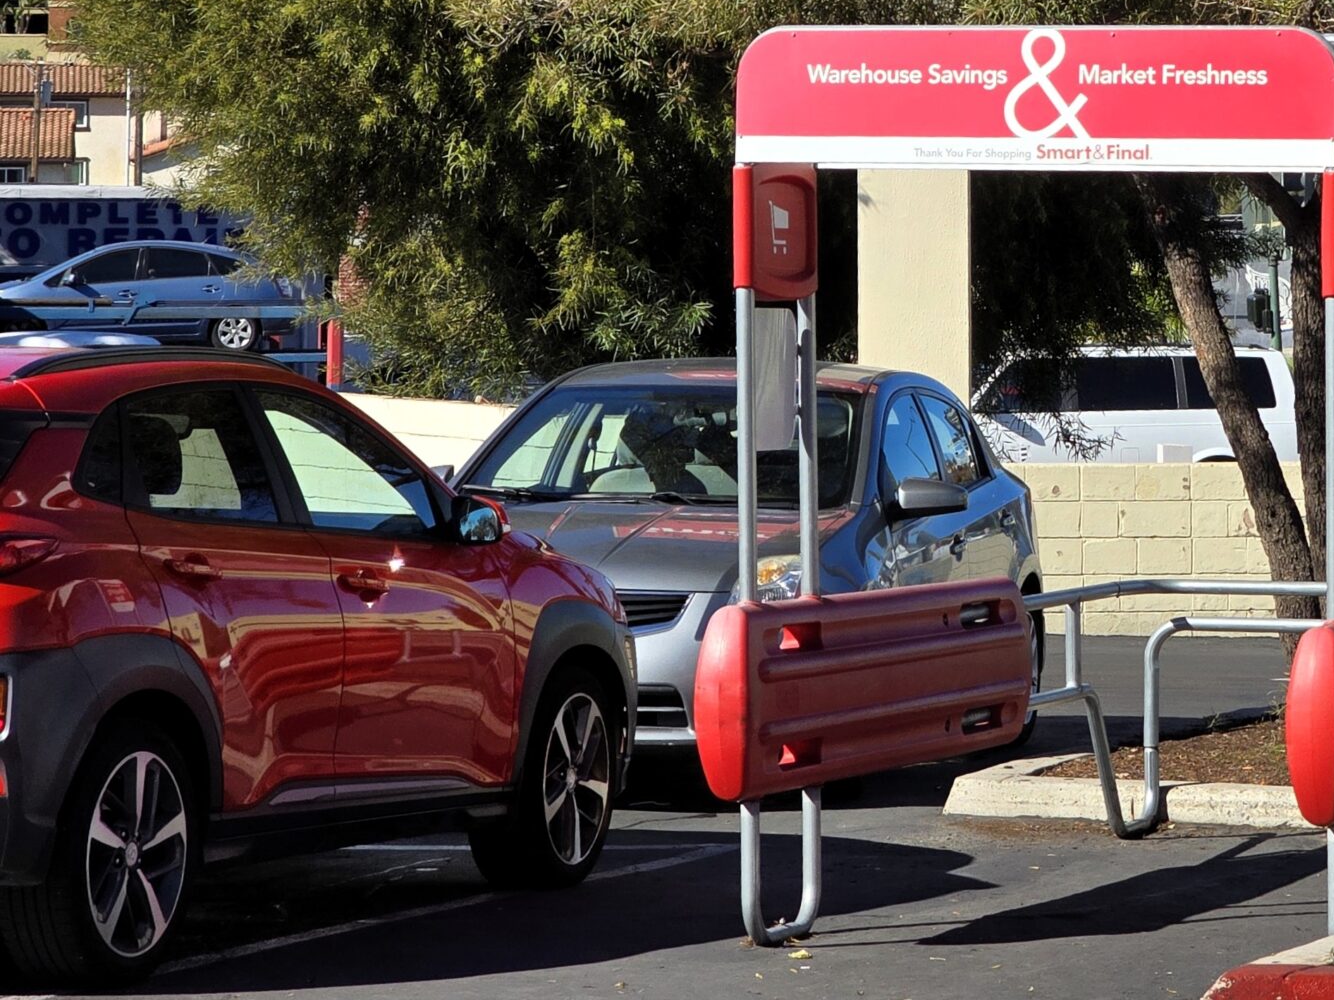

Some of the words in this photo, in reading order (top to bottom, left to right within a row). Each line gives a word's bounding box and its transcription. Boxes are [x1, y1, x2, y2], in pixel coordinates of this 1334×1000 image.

[807, 63, 922, 84] Warehouse
[928, 63, 1008, 90] Savings
[1004, 28, 1091, 138] &
[1078, 63, 1156, 85] Market
[1162, 63, 1268, 85] Freshness
[914, 147, 943, 158] Thank
[945, 148, 964, 158] You
[966, 148, 982, 158] For
[985, 148, 1031, 161] Shopping
